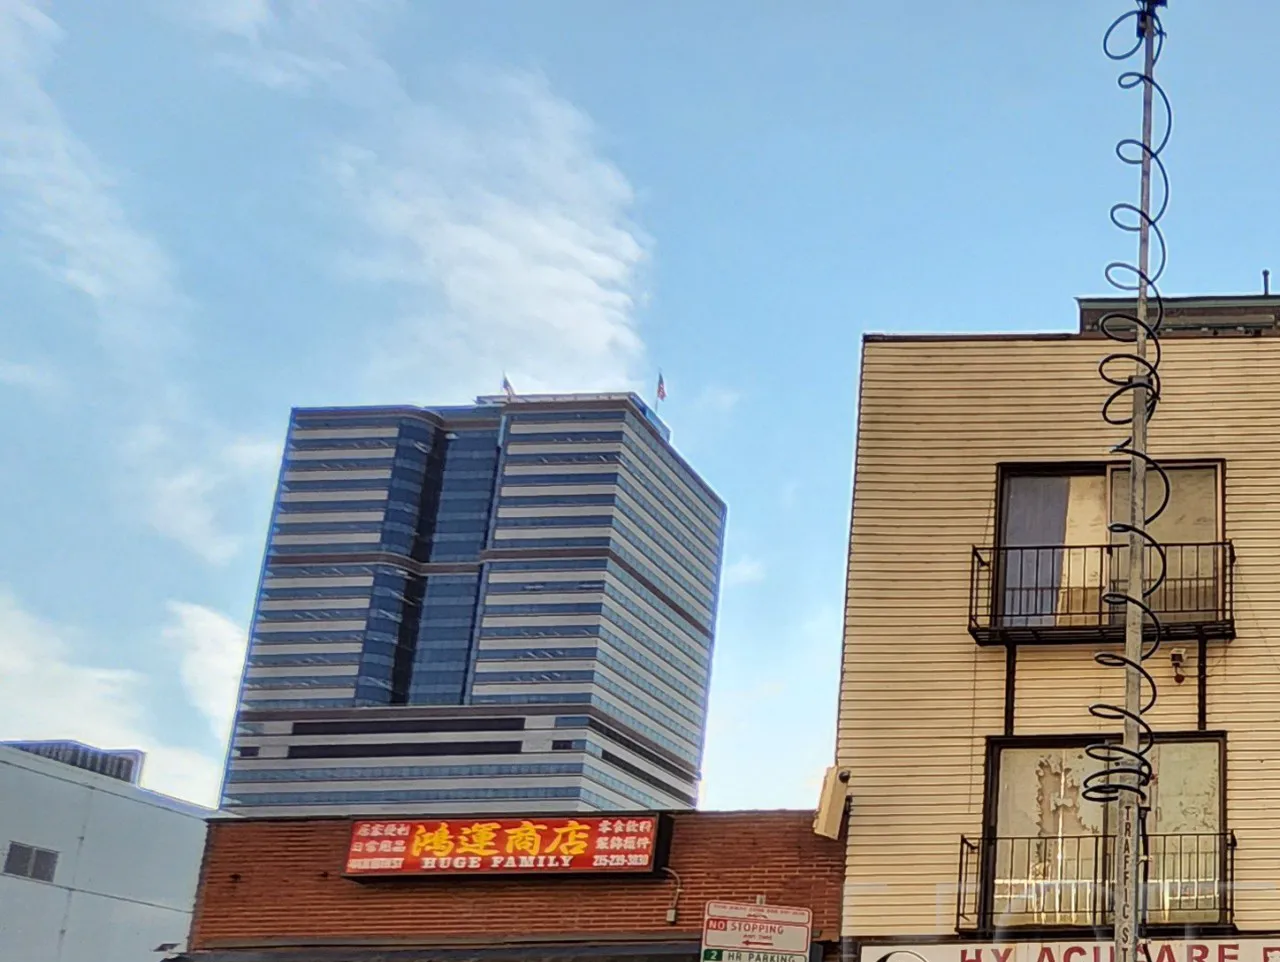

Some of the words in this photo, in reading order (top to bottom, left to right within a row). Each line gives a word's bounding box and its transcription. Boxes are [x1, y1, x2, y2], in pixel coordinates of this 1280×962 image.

[410, 820, 591, 857] 鴻運商店
[421, 856, 481, 868] HUGE
[490, 855, 574, 868] FAMILY
[1119, 806, 1132, 918] TRAFFIC
[708, 919, 726, 930] NO
[730, 922, 784, 935] STOPPING
[710, 951, 718, 960] 2
[727, 952, 742, 961] HR
